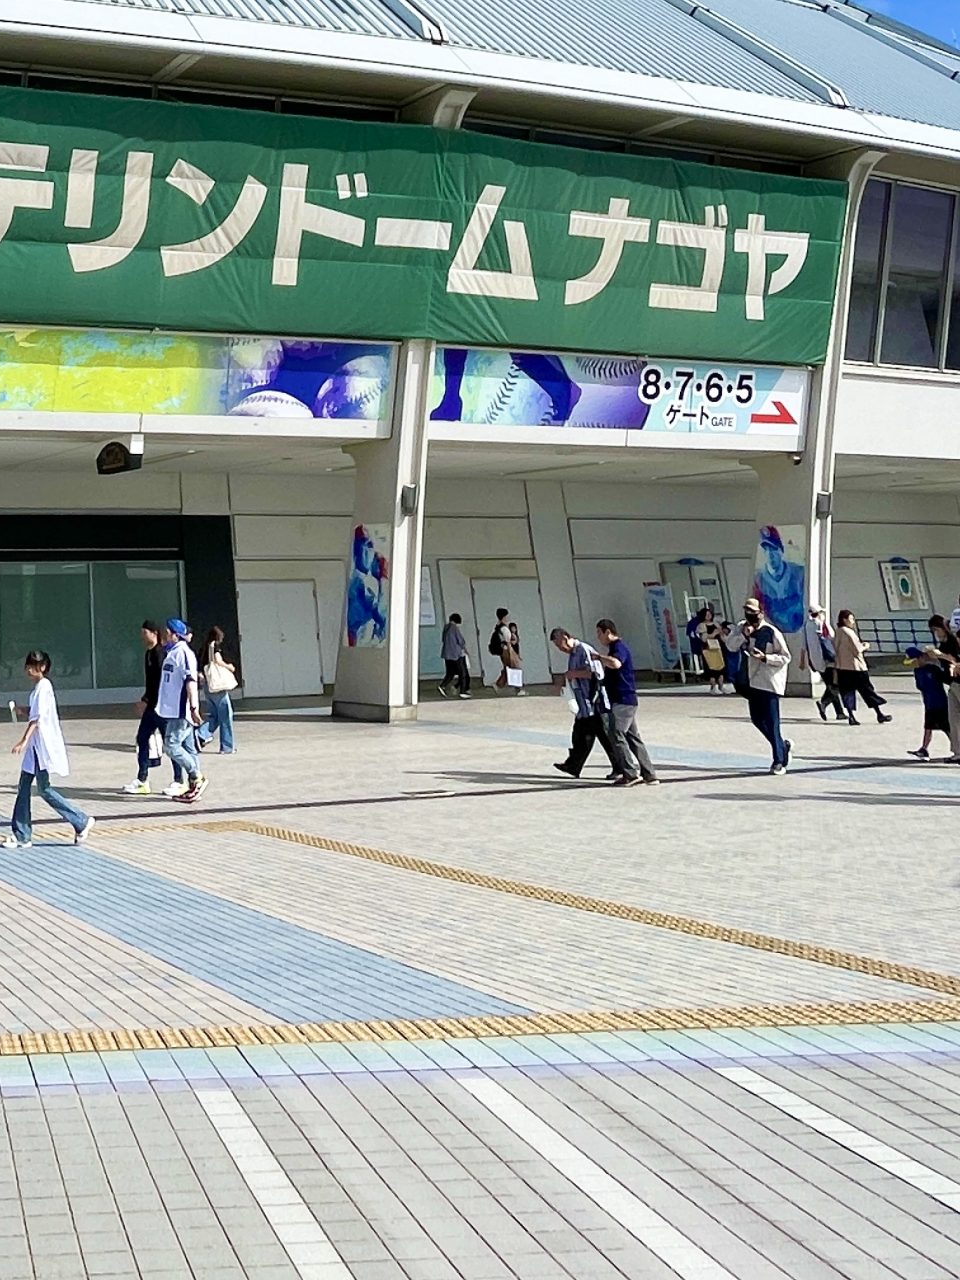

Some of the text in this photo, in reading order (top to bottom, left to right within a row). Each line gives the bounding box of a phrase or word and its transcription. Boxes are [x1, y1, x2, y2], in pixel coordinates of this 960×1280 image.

[563, 197, 811, 322] ナゴヤ
[666, 404, 734, 427] ゲート GATE
